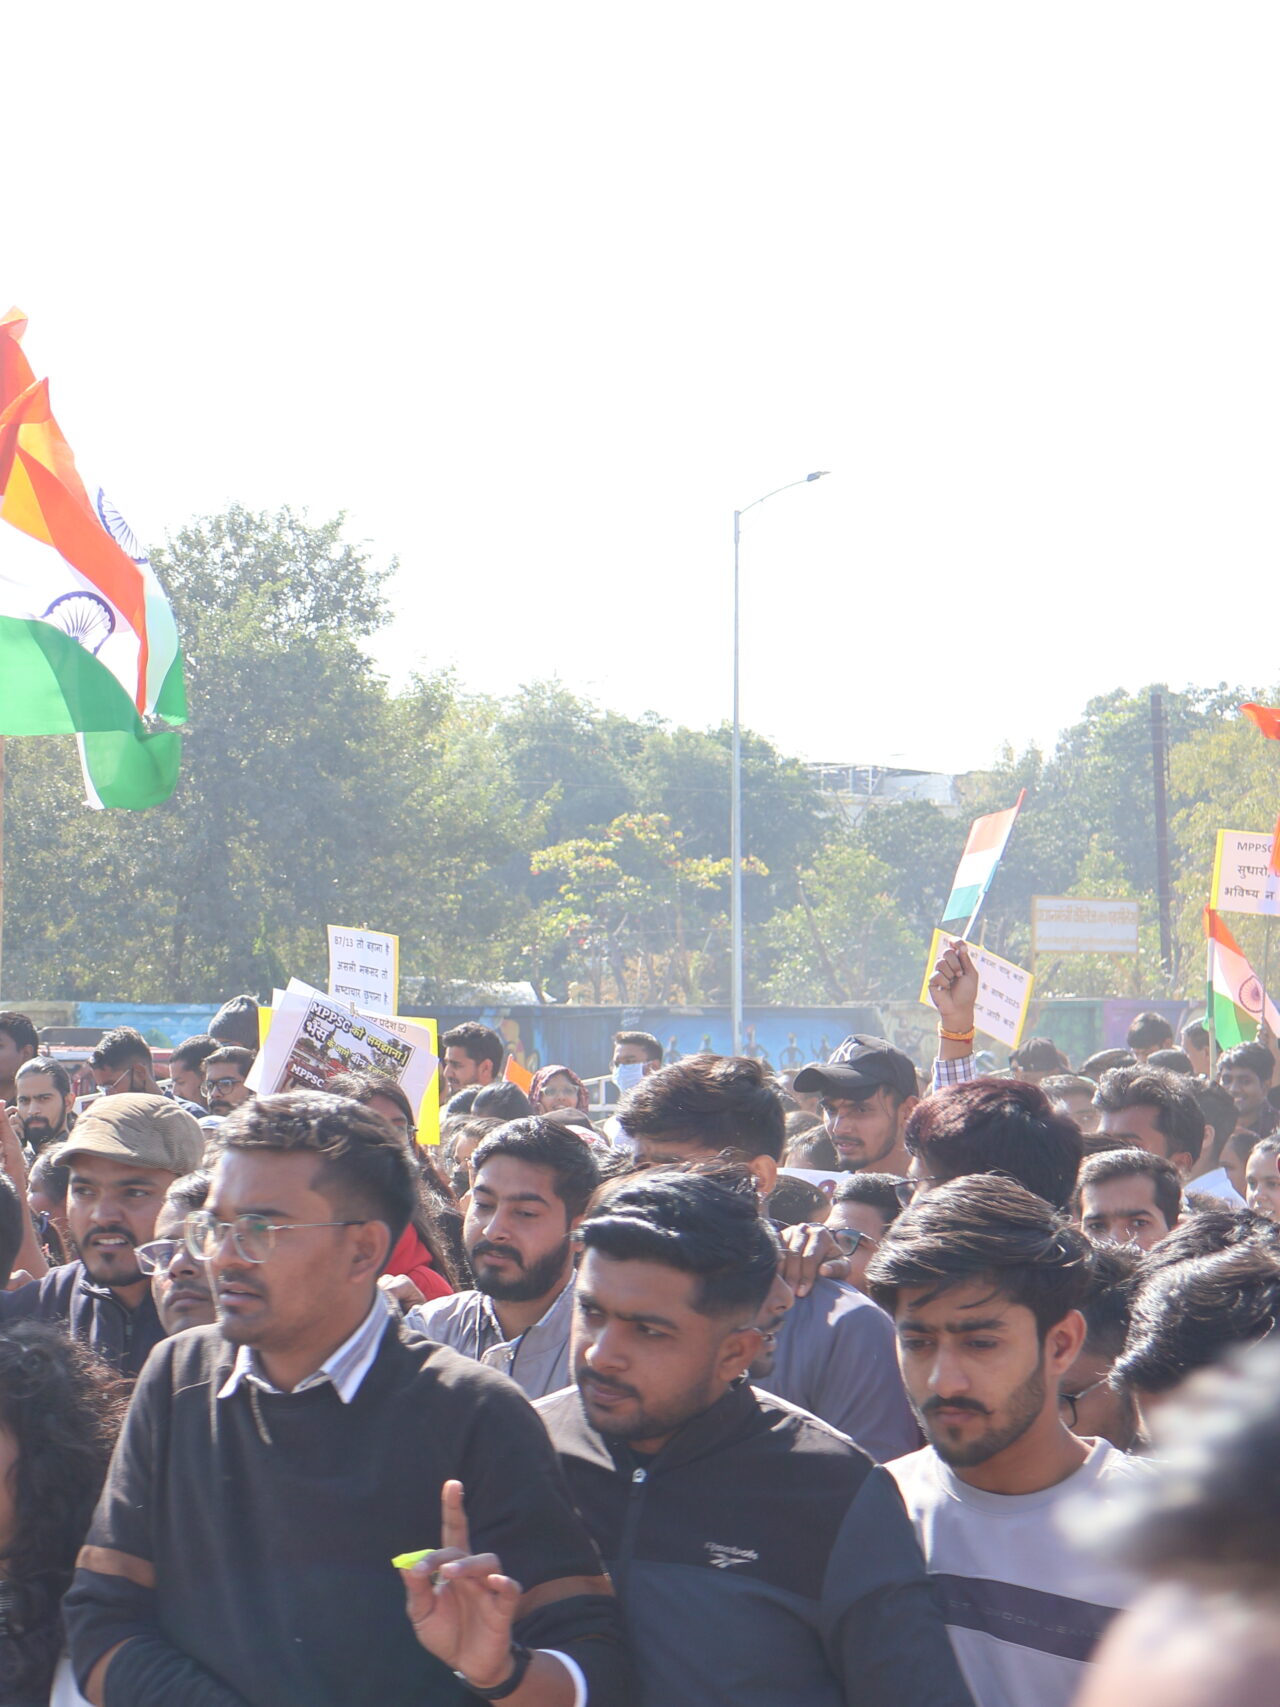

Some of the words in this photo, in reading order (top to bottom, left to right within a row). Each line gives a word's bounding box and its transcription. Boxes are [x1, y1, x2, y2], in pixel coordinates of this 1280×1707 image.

[1224, 885, 1260, 899] भविष्य
[1265, 890, 1275, 901] न
[309, 1002, 352, 1032] MPPSC
[351, 1026, 366, 1041] को
[290, 1063, 325, 1088] MPPSC
